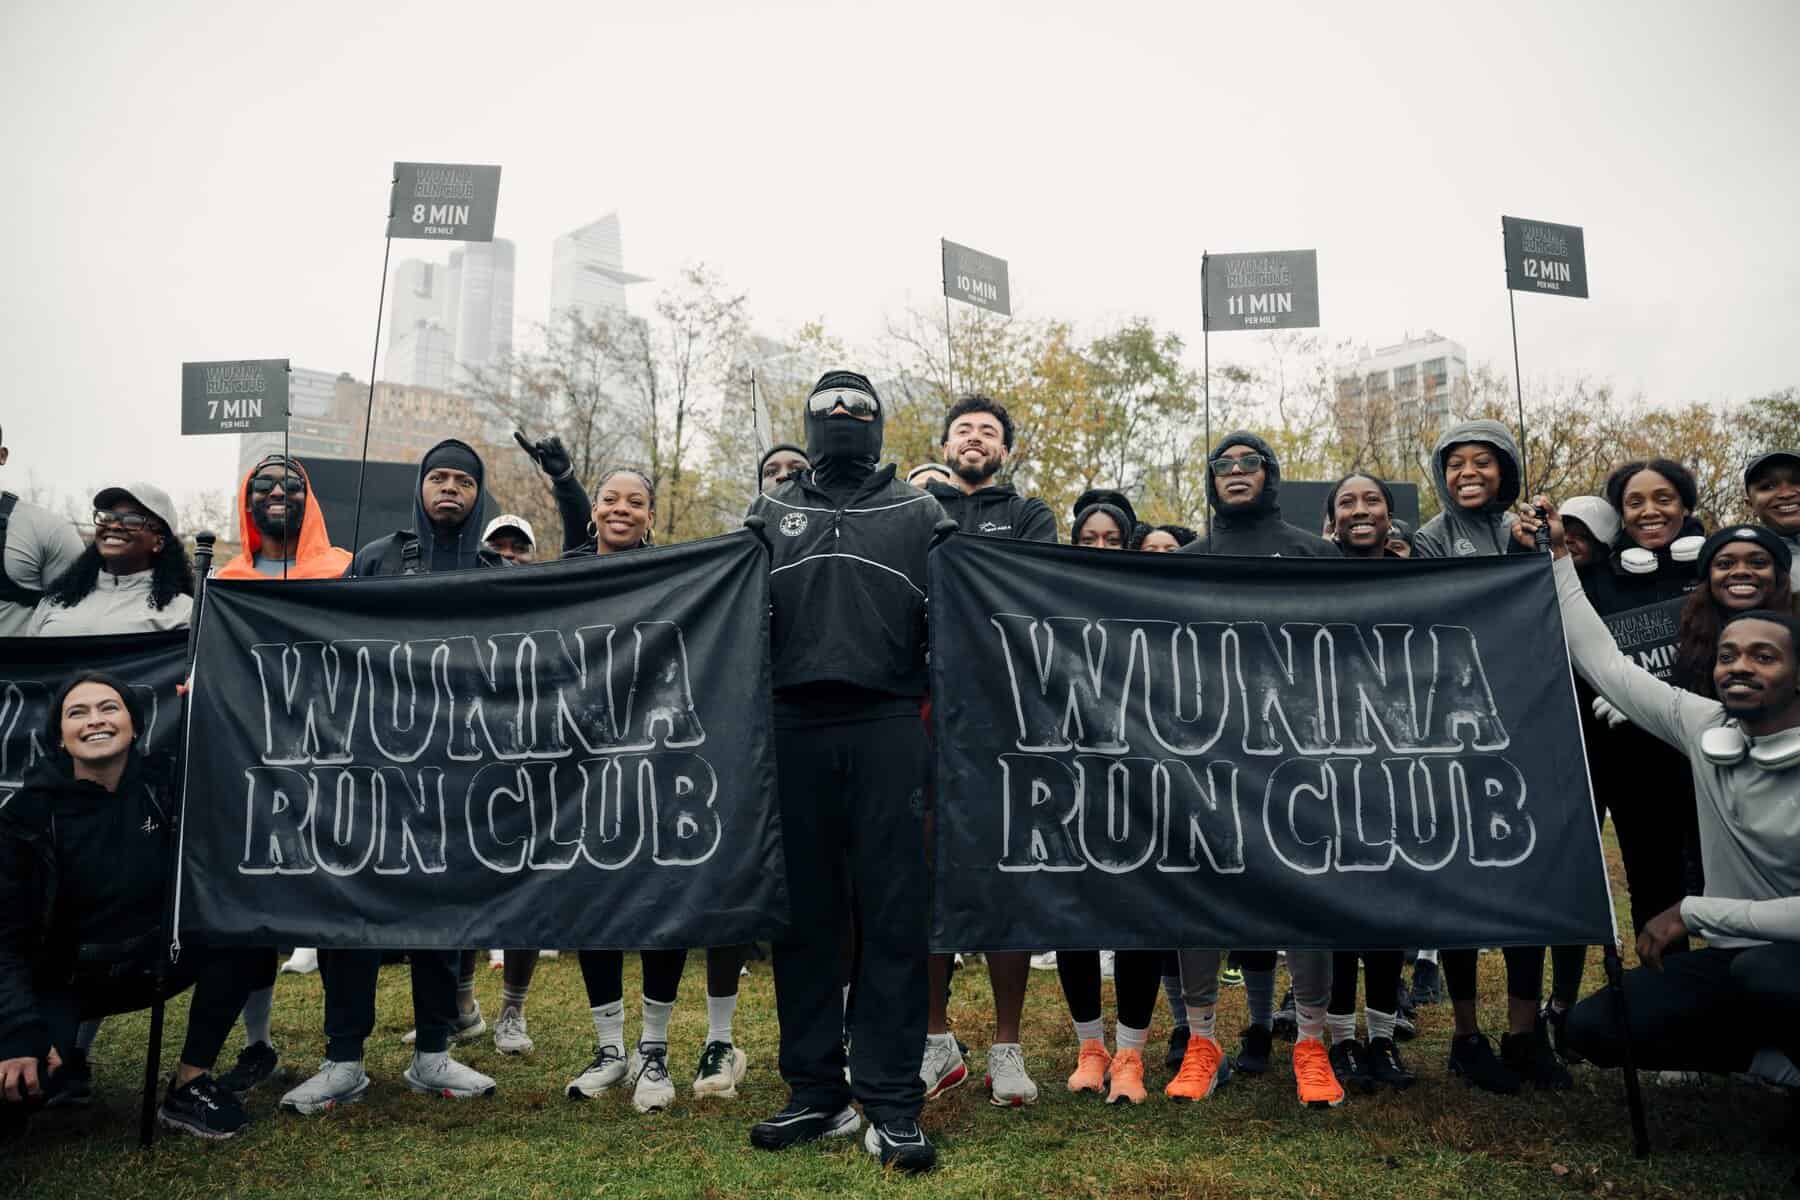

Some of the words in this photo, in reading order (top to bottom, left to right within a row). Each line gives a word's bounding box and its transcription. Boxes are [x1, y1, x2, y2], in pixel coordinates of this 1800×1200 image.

[412, 204, 425, 224] 8
[429, 204, 470, 225] MIN
[1523, 257, 1538, 278] 12
[1540, 260, 1571, 282] MIN
[957, 275, 970, 291] 10
[972, 279, 997, 301] MIN
[1226, 295, 1244, 315] 11
[1249, 292, 1292, 314] MIN
[208, 401, 219, 420] 7
[223, 399, 264, 419] MIN
[220, 421, 233, 429] PER
[234, 420, 249, 428] MILE
[251, 621, 705, 766] WUNNA
[991, 613, 1510, 755] WUNNA
[238, 766, 448, 875] RUN
[464, 752, 722, 874] CLUB
[997, 753, 1246, 875] RUN
[1262, 755, 1537, 875] CLUB
